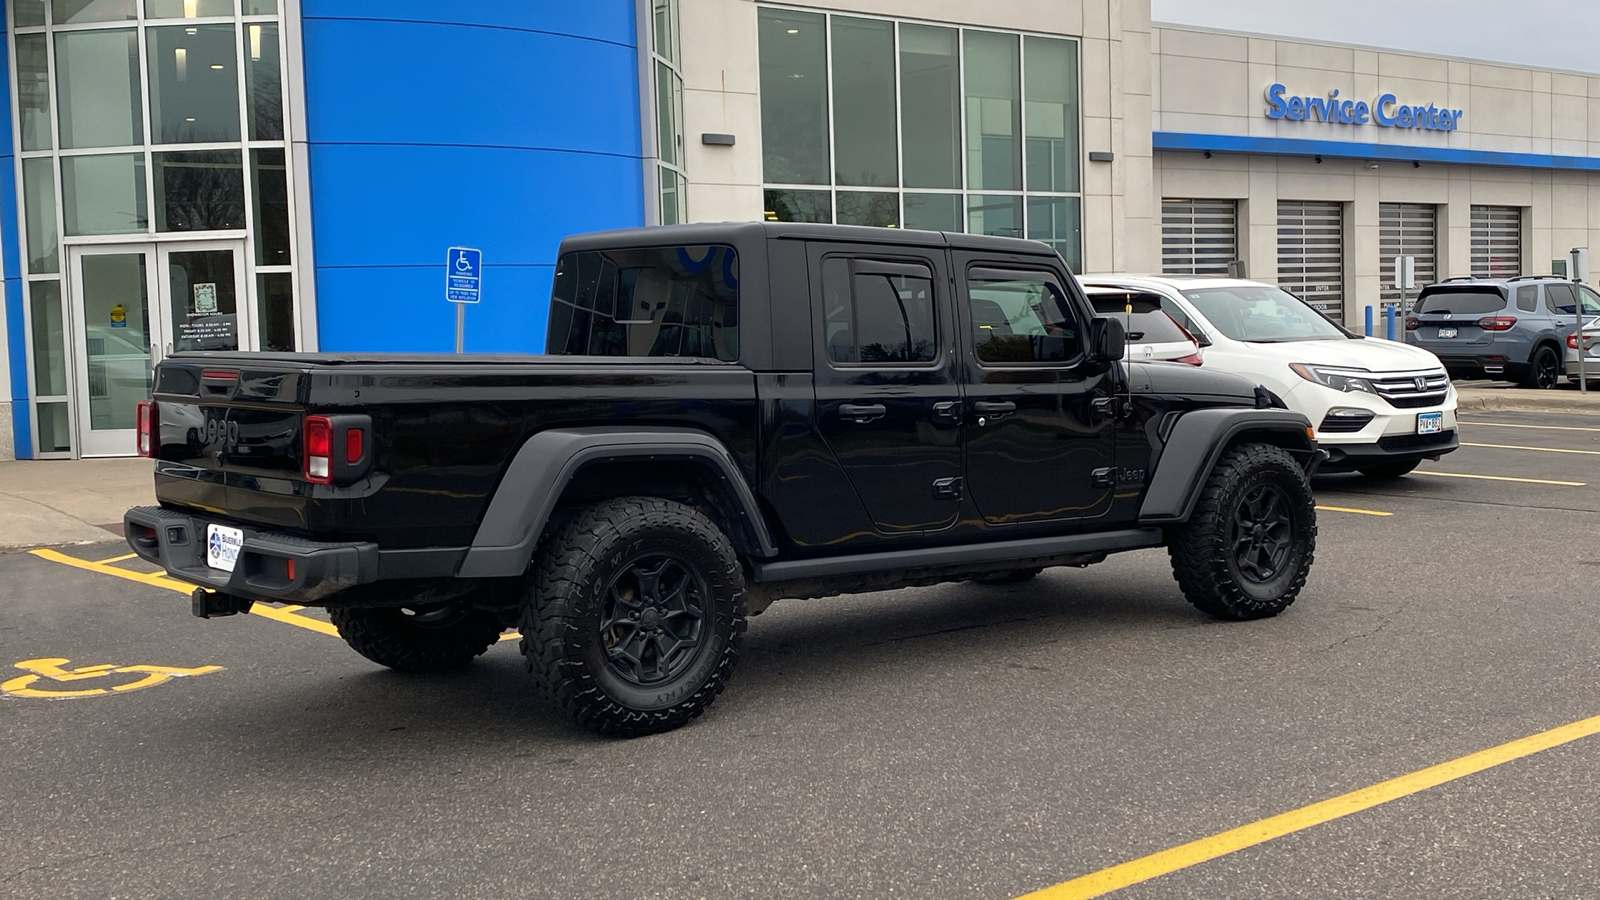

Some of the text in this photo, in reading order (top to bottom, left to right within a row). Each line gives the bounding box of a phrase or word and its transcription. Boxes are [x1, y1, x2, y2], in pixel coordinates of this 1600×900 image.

[1264, 83, 1463, 131] Service Center
[198, 410, 239, 453] Jeep
[1119, 467, 1144, 482] Jeep
[222, 534, 242, 546] BUERKLE
